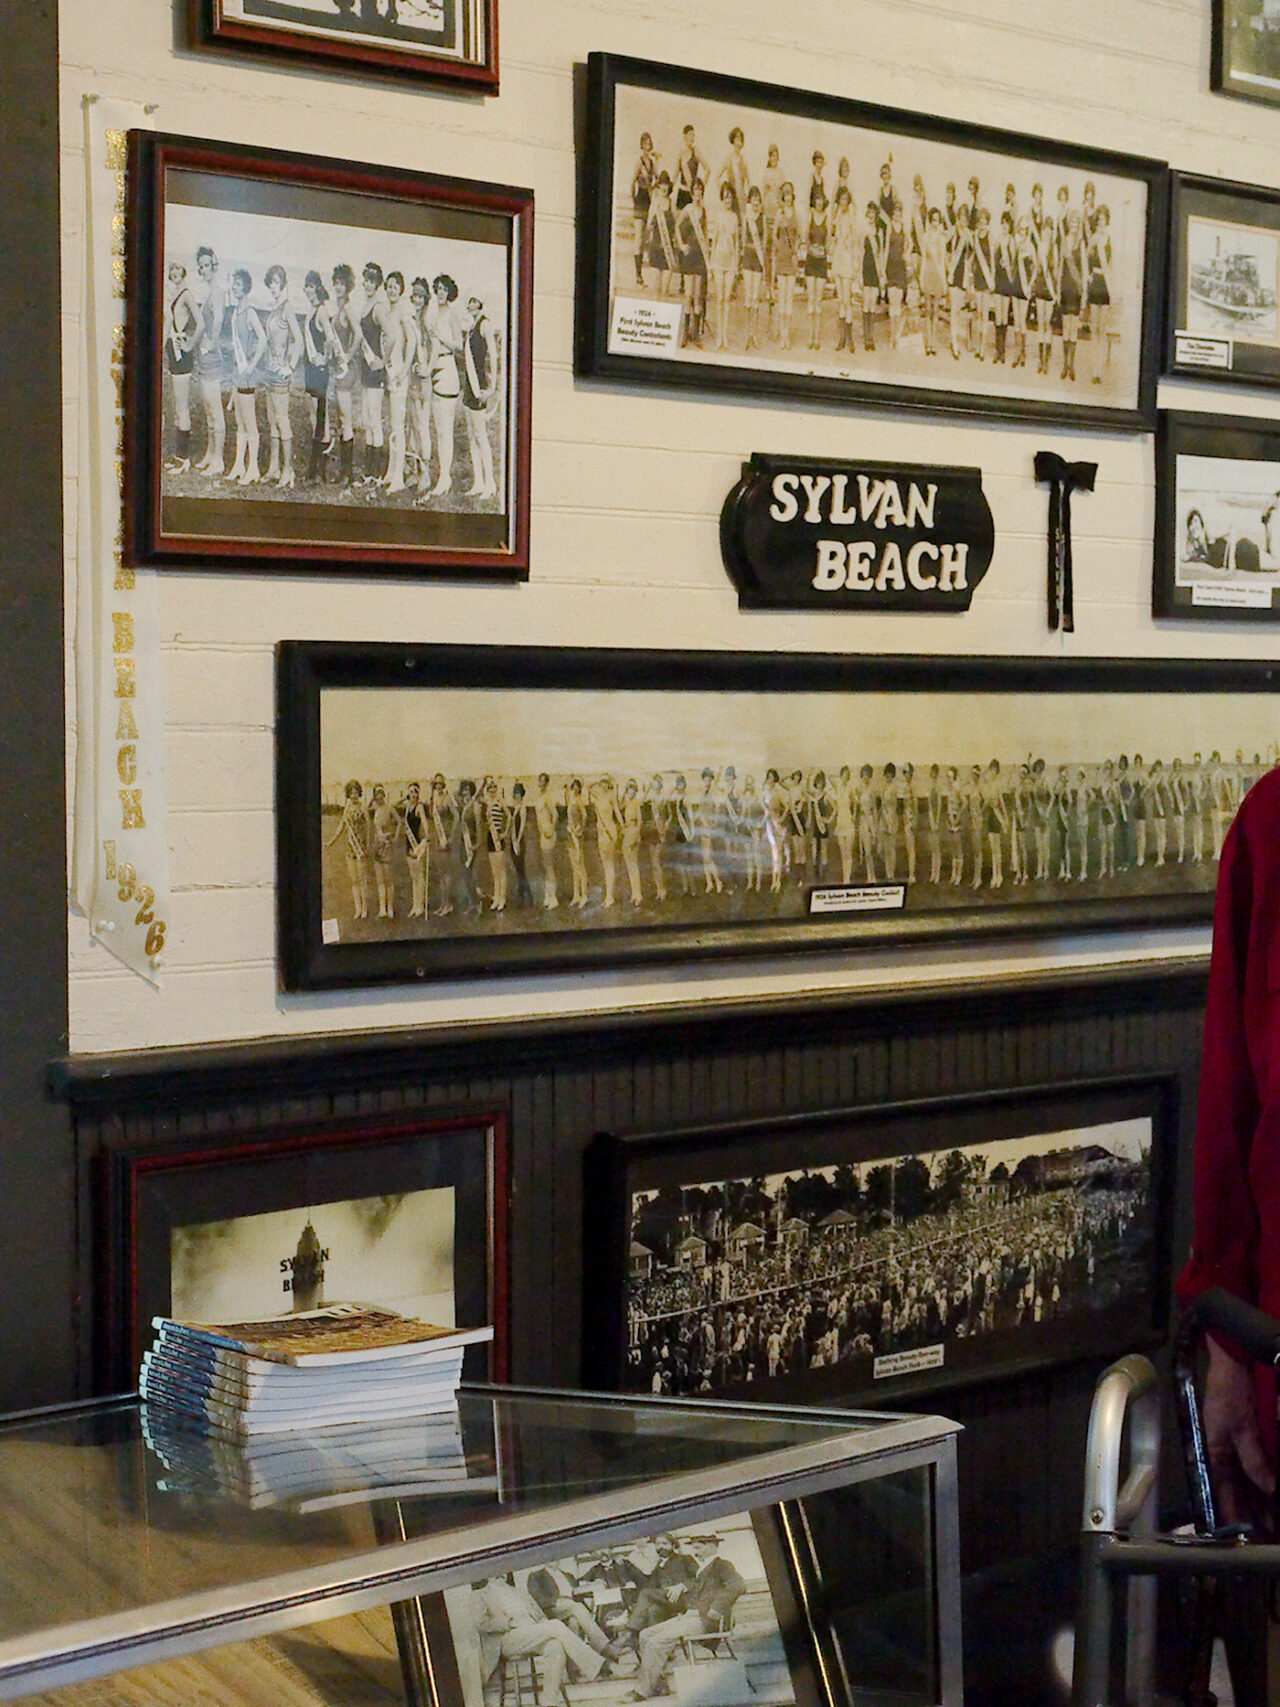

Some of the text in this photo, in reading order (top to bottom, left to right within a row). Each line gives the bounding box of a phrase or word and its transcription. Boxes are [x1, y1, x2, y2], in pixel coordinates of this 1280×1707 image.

[769, 473, 938, 529] SYLVAN
[812, 540, 970, 592] BEACH
[112, 612, 146, 829] BEACH
[103, 839, 167, 957] 1926
